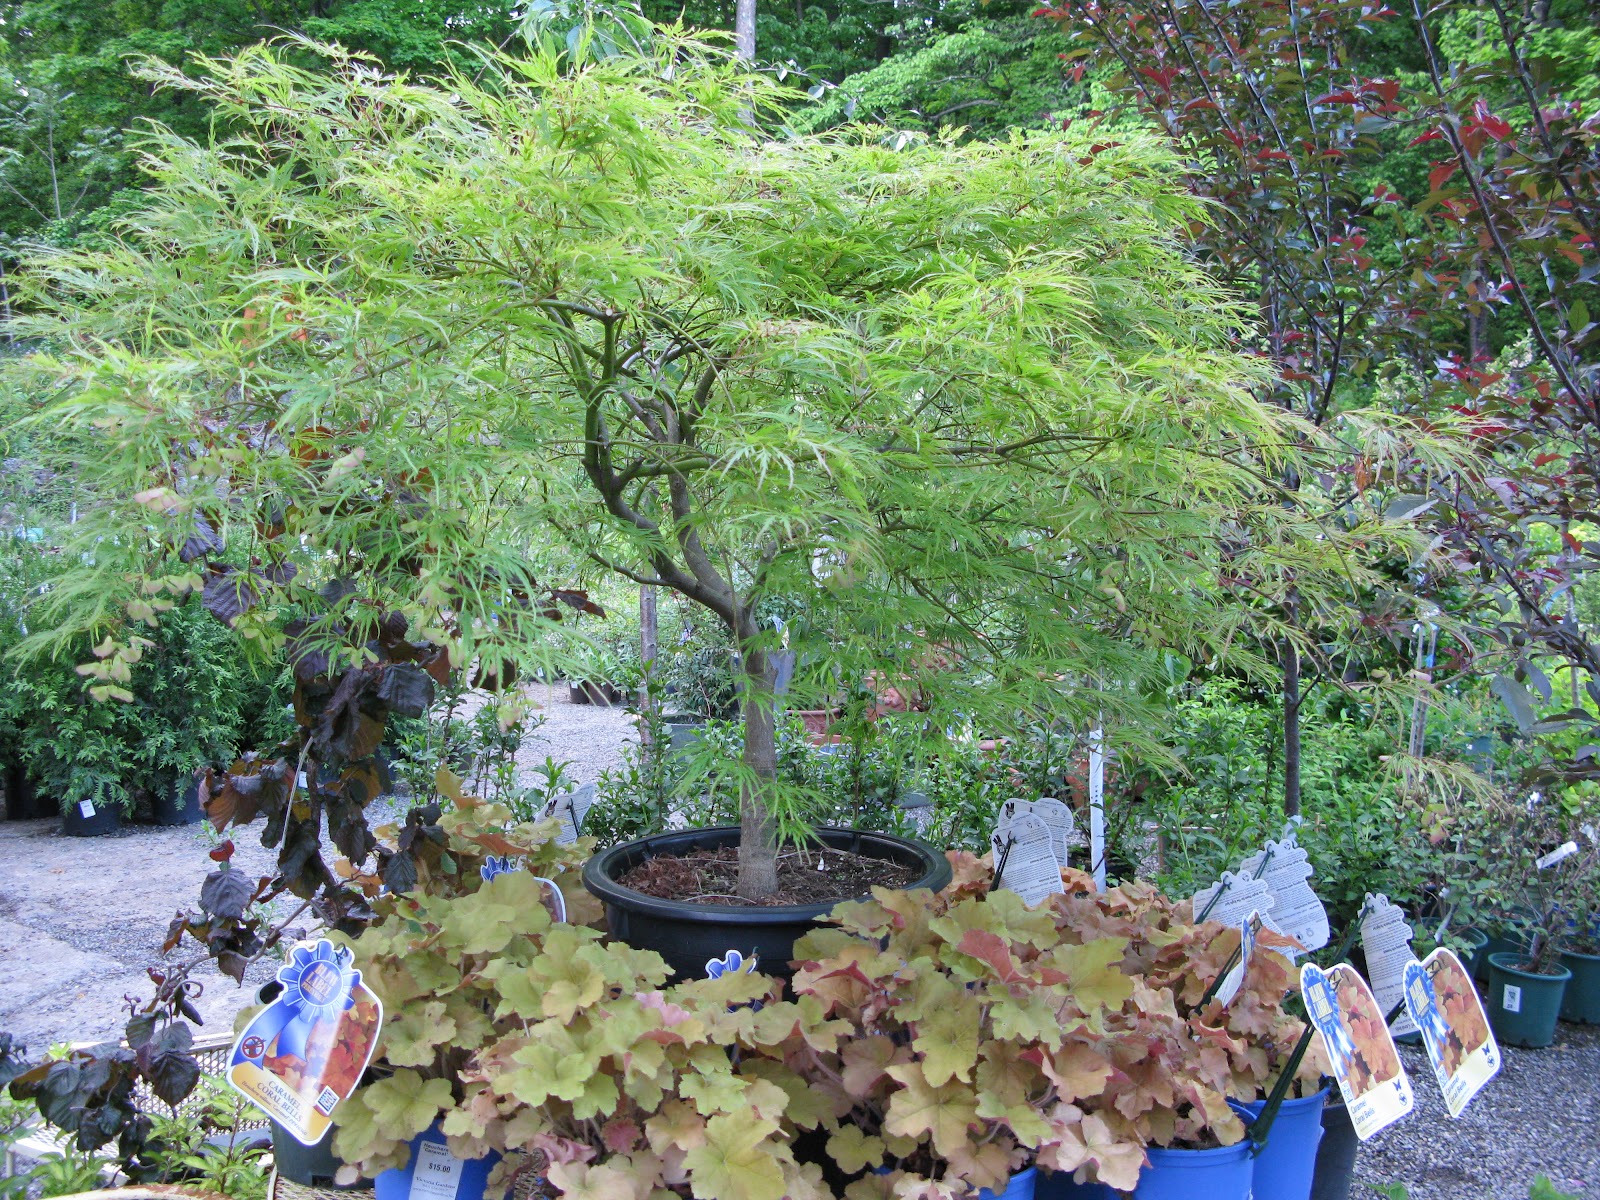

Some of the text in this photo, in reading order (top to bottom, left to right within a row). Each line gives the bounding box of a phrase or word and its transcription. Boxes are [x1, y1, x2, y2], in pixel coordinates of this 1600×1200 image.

[305, 971, 333, 996] LABEL
[256, 1082, 304, 1122] CORAL BELLS
[268, 1080, 302, 1110] CARAMEL
[1350, 1099, 1367, 1114] Caramel
[428, 1163, 451, 1173] $15.00
